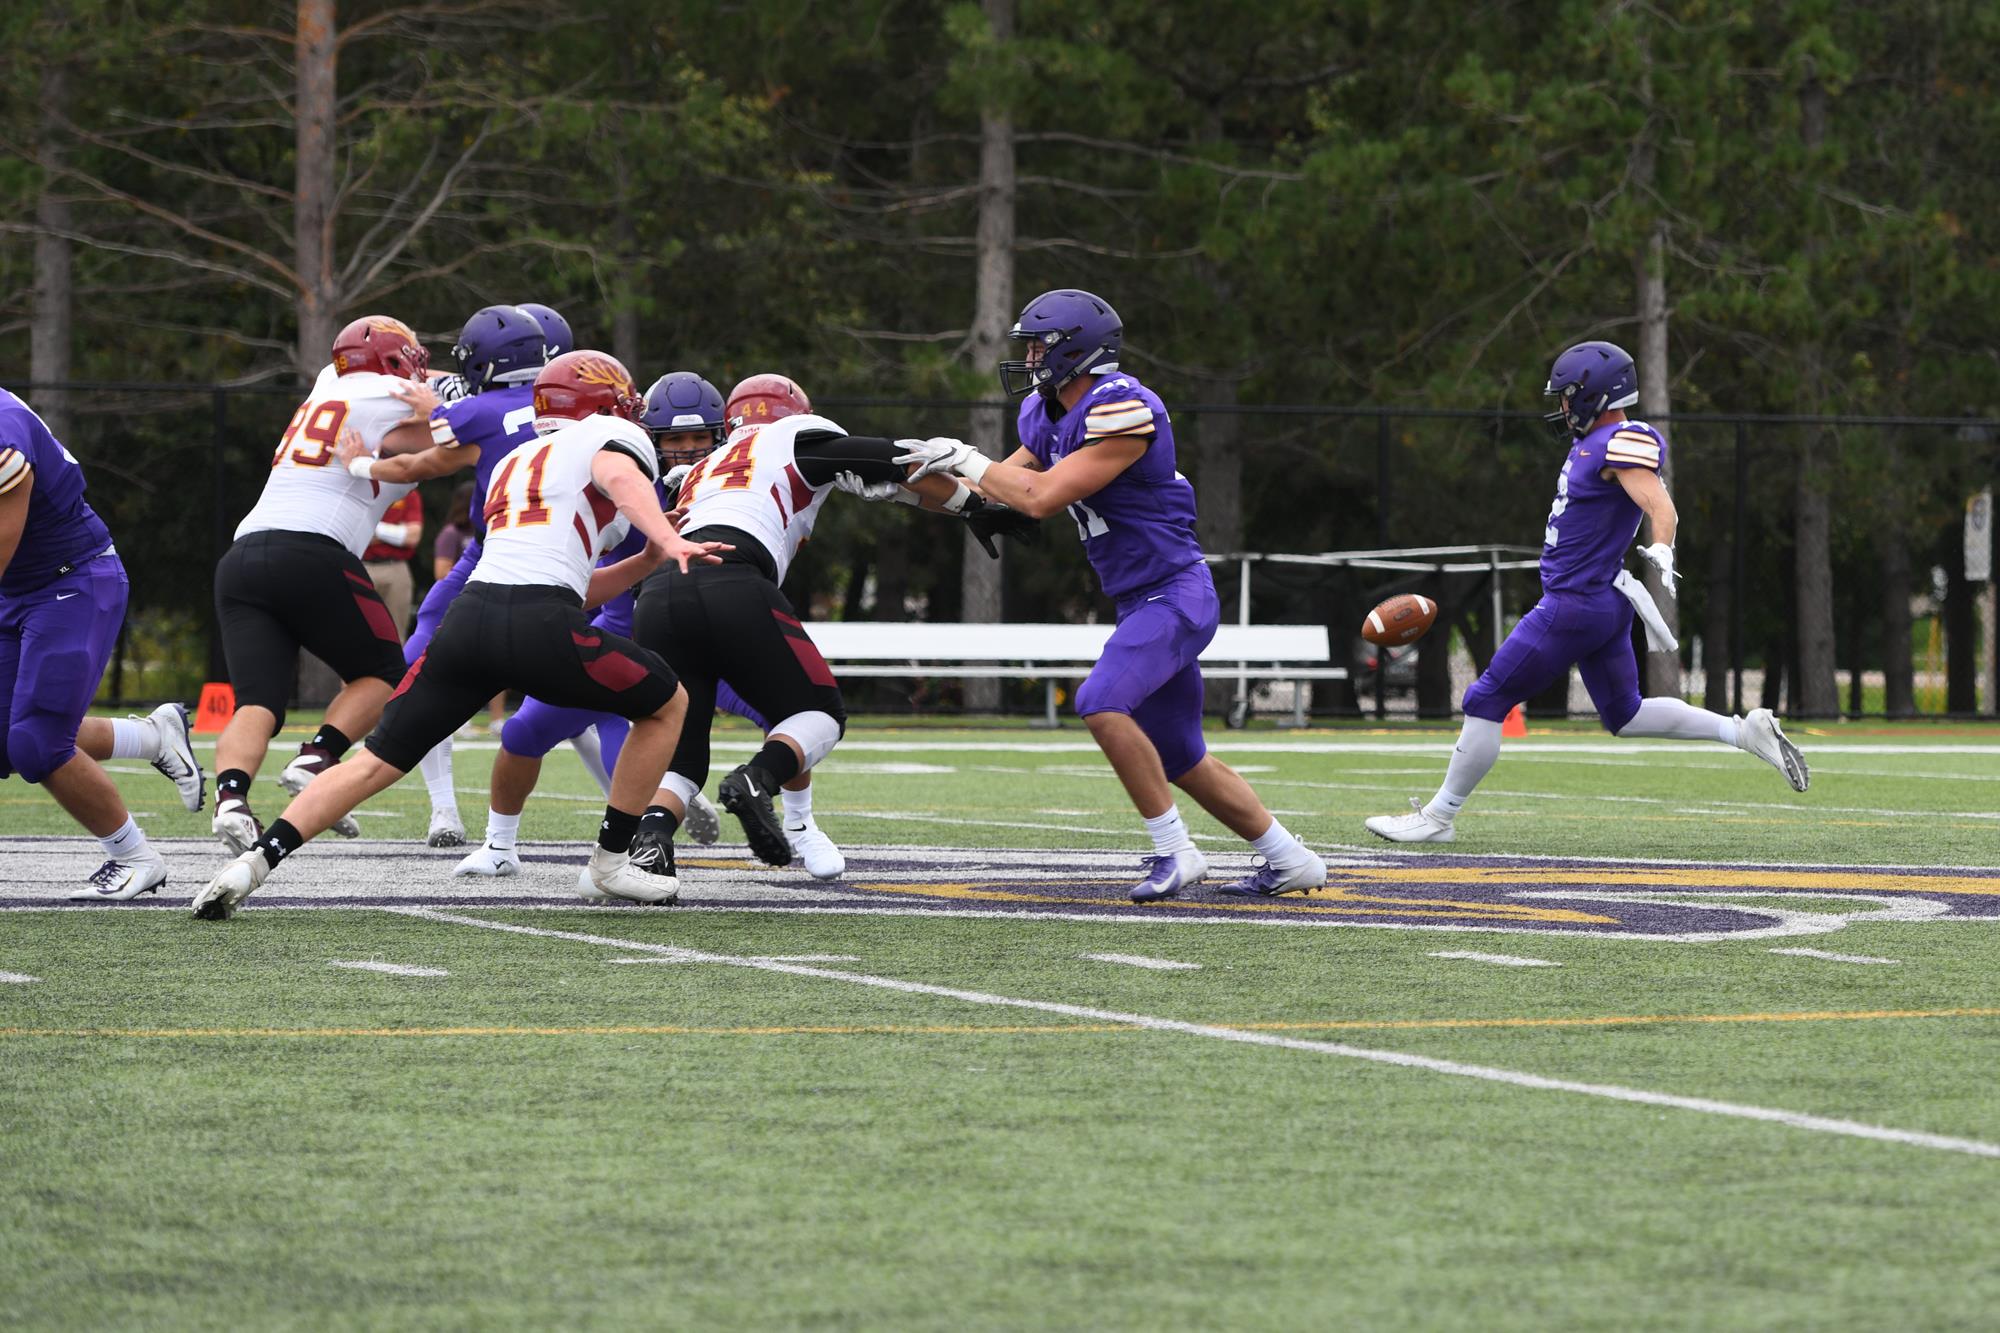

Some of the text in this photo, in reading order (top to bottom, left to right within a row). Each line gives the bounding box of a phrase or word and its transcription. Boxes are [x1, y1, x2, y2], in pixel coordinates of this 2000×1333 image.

[741, 400, 768, 417] 44
[483, 442, 554, 535] 41
[675, 431, 757, 508] 44
[207, 695, 228, 717] 40
